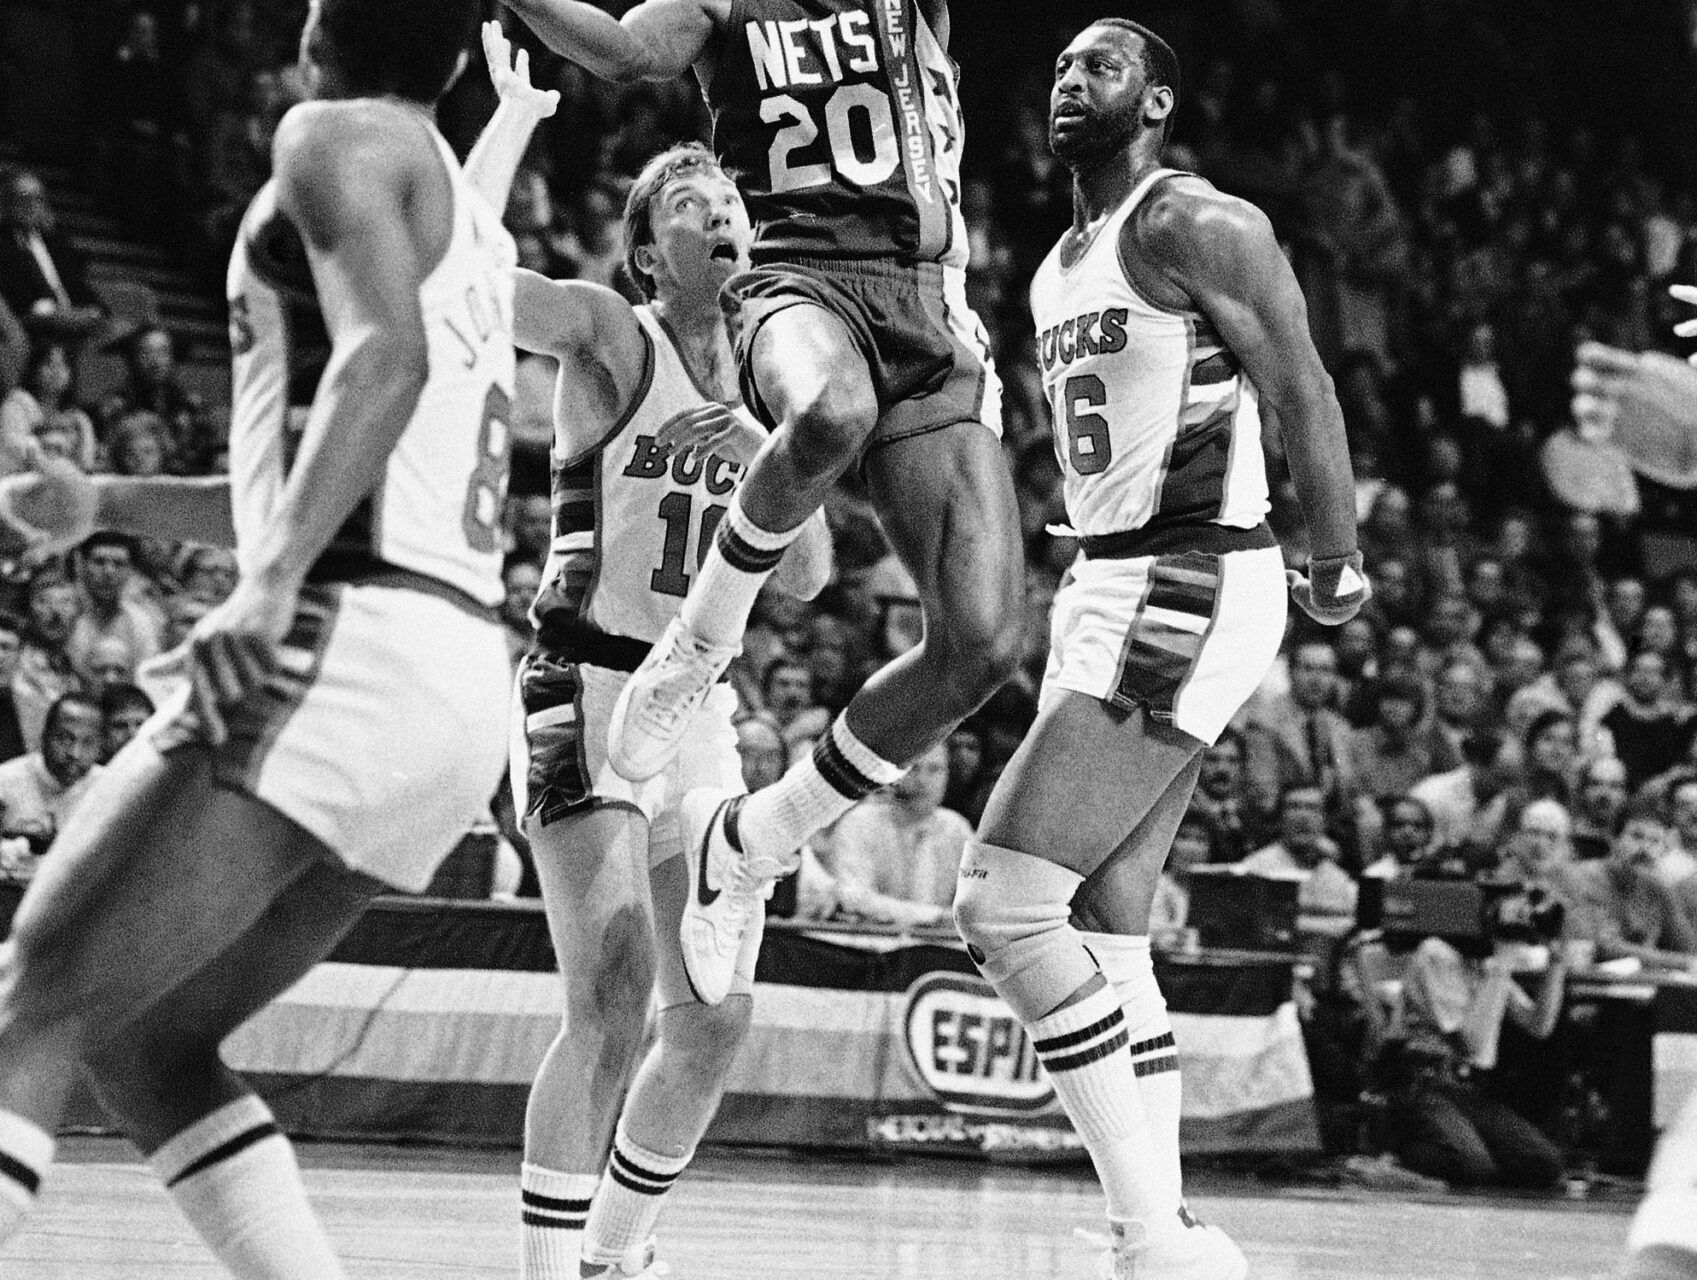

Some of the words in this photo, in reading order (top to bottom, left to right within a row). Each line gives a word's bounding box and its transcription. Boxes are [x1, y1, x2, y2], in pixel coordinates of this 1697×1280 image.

[745, 9, 879, 91] NETS
[758, 82, 900, 193] 20
[894, 64, 933, 204] JERSEY
[1035, 307, 1128, 372] UCKS
[460, 381, 512, 556] 8
[622, 434, 748, 496] BUC
